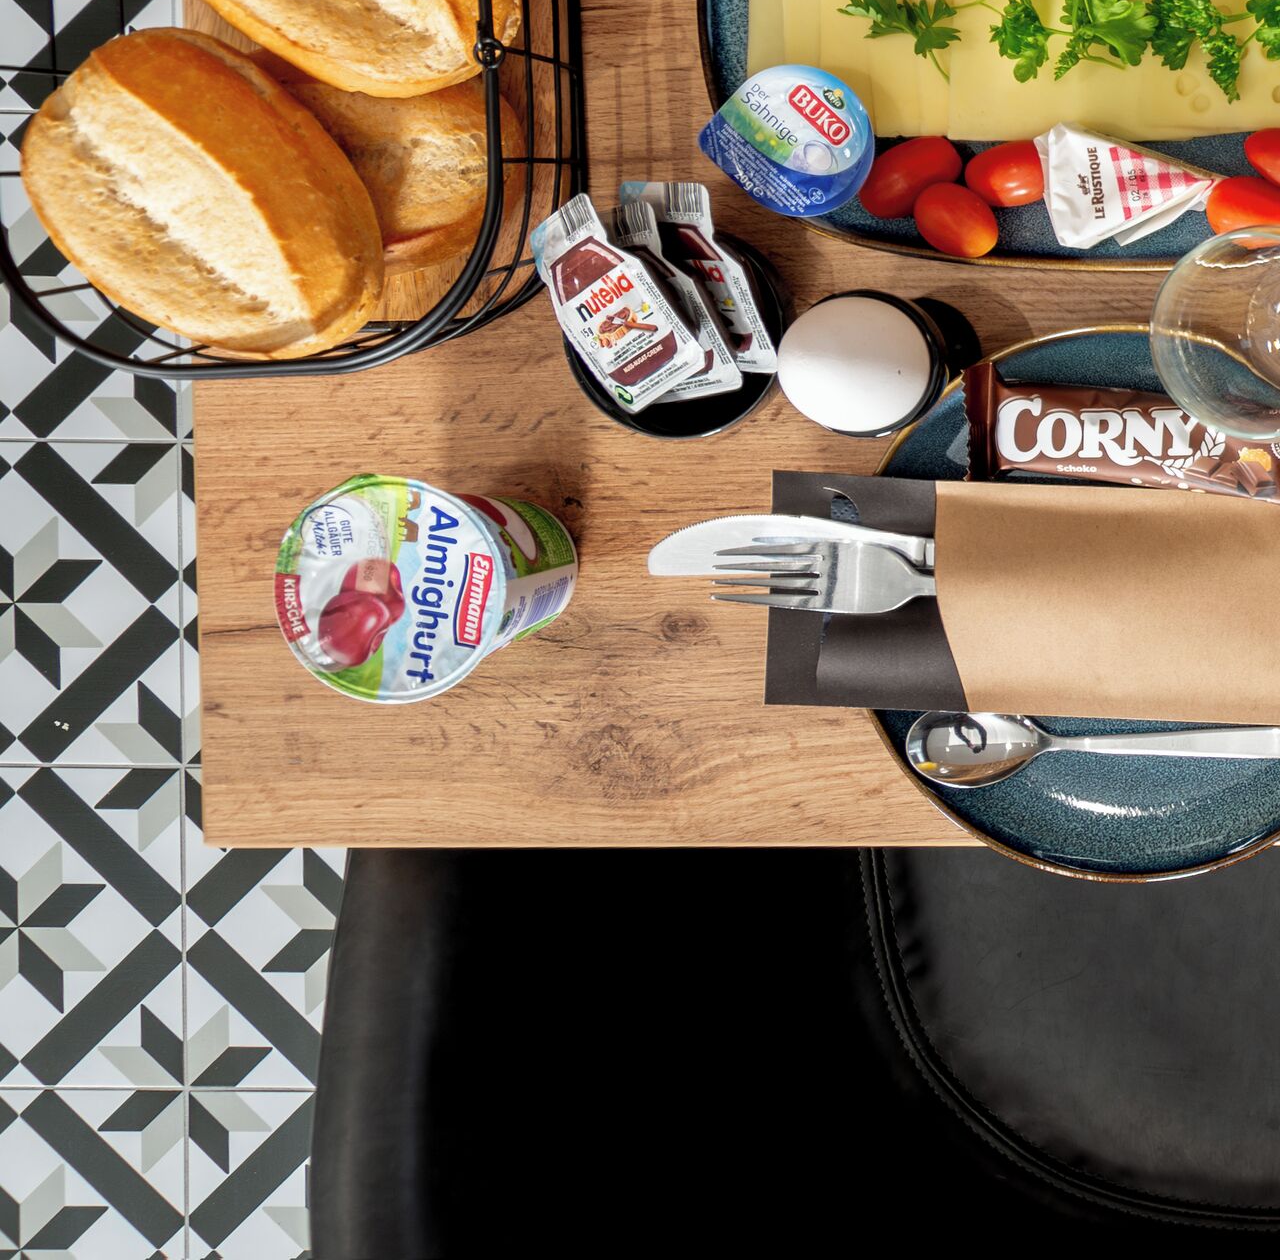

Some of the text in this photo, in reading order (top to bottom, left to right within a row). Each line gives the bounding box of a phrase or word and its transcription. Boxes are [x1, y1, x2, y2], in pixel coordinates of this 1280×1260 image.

[750, 83, 770, 100] Der
[792, 88, 846, 141] BUKO
[824, 91, 842, 108] Arla
[741, 92, 798, 146] Sahnige
[1087, 147, 1106, 220] LE RUSTIQUE
[575, 272, 635, 322] nutella
[997, 396, 1199, 467] CORNY
[1056, 464, 1098, 473] Schoko
[323, 510, 342, 557] ALLGÄUER
[339, 519, 353, 544] GUTE
[283, 578, 302, 634] KIRSCHE
[406, 505, 460, 683] Almighurt
[464, 555, 490, 641] Ehrmann
